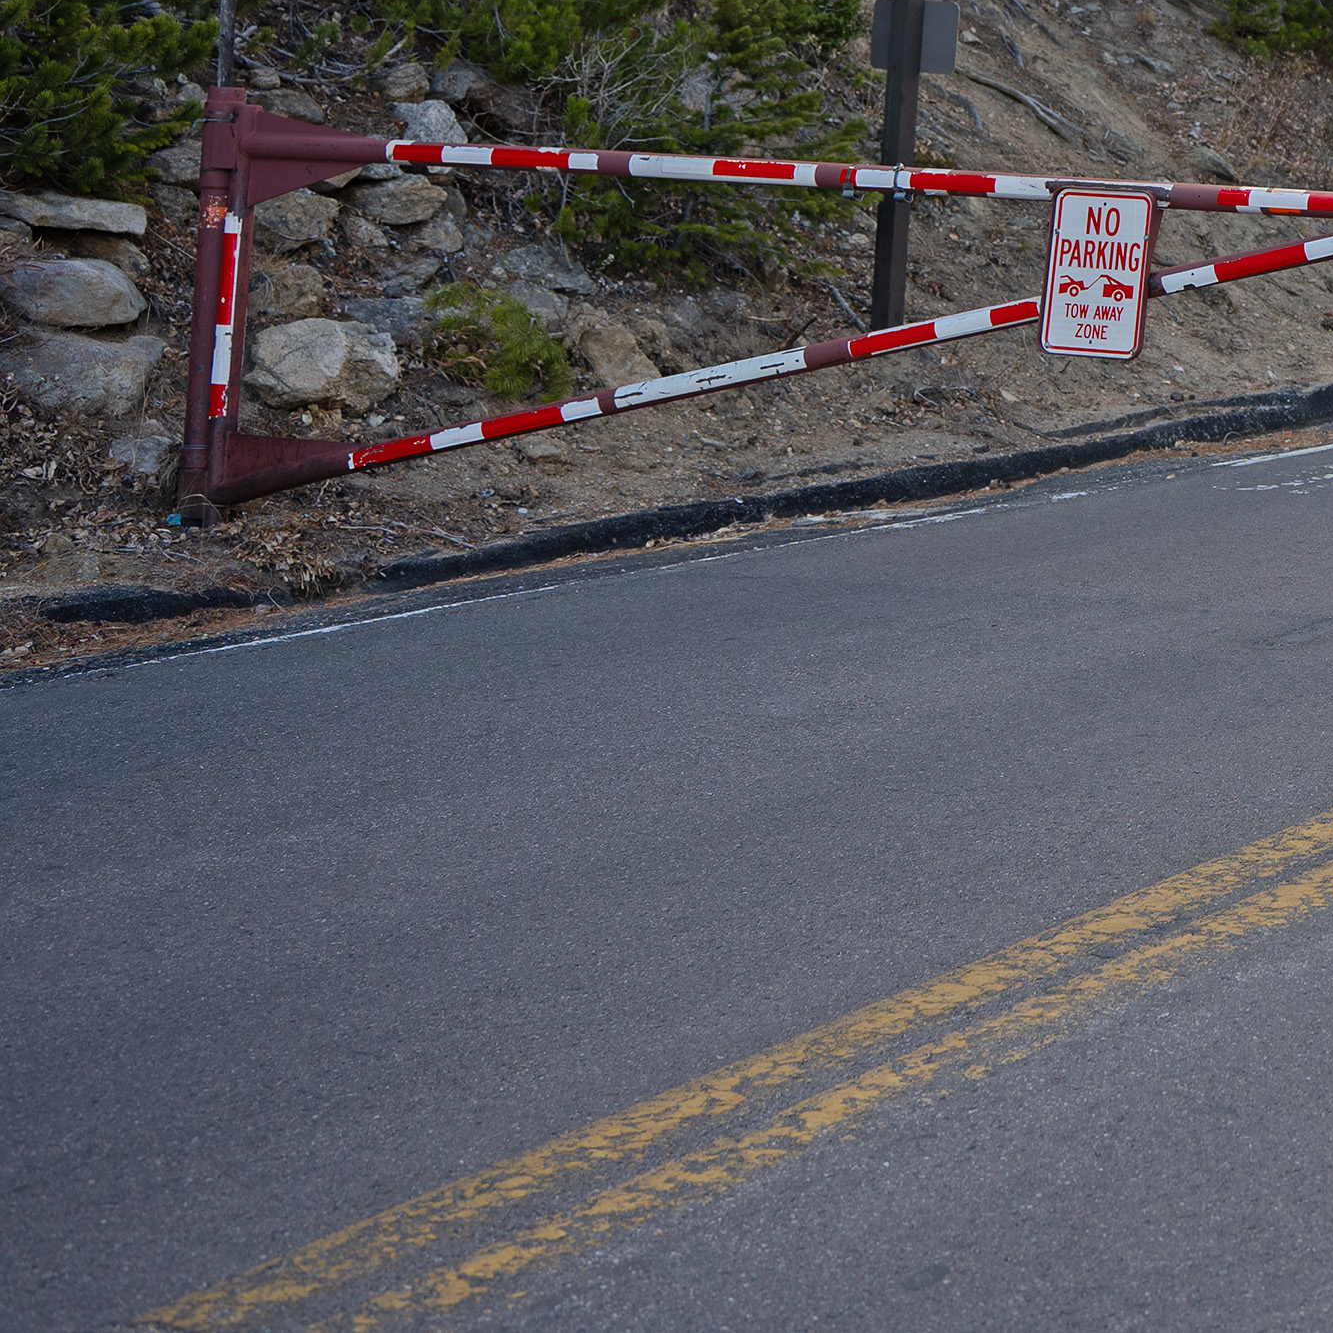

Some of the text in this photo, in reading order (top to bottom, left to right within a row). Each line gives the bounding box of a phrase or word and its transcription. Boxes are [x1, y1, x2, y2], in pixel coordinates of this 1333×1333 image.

[1086, 207, 1120, 237] NO
[1059, 239, 1141, 272] PARKING
[1065, 303, 1124, 321] TOW AWAY
[1075, 324, 1108, 340] ZONE
